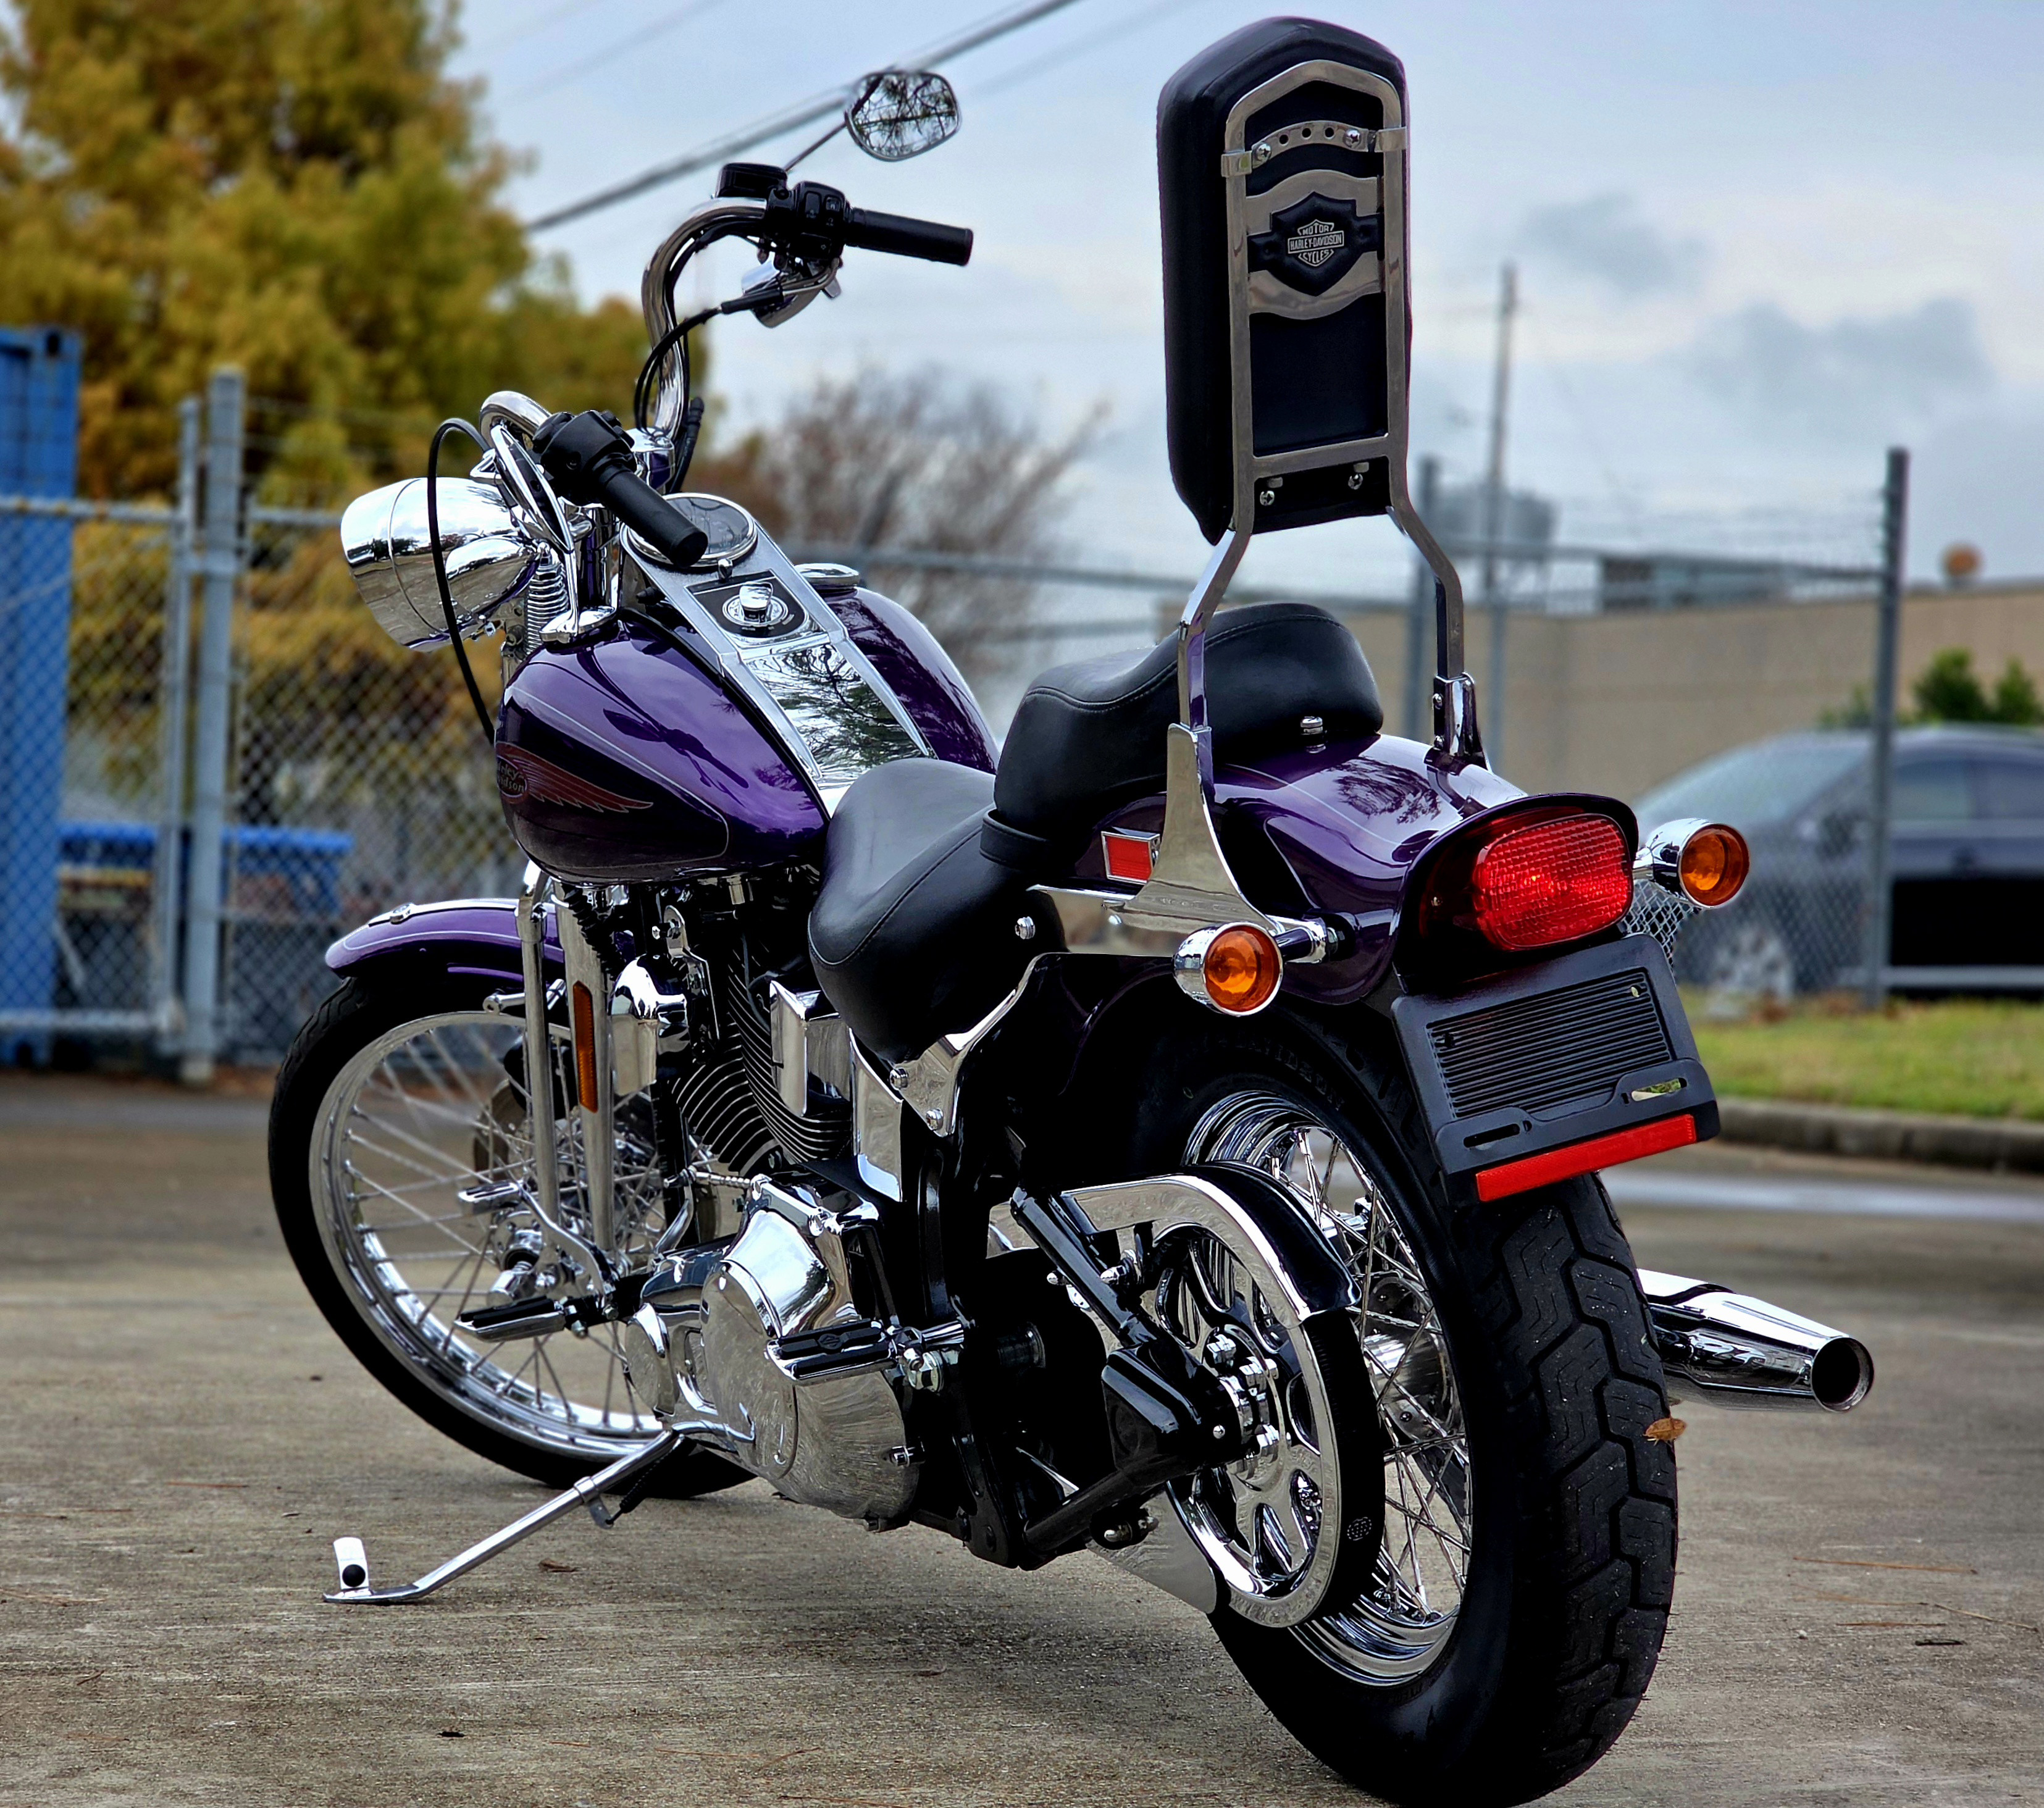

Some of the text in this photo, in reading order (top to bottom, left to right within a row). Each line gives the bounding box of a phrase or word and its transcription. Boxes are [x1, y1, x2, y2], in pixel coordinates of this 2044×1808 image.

[1302, 223, 1329, 235] MOTOR
[1290, 234, 1342, 250] HARLEY-DAVIDSON
[1302, 249, 1330, 264] CYCLES
